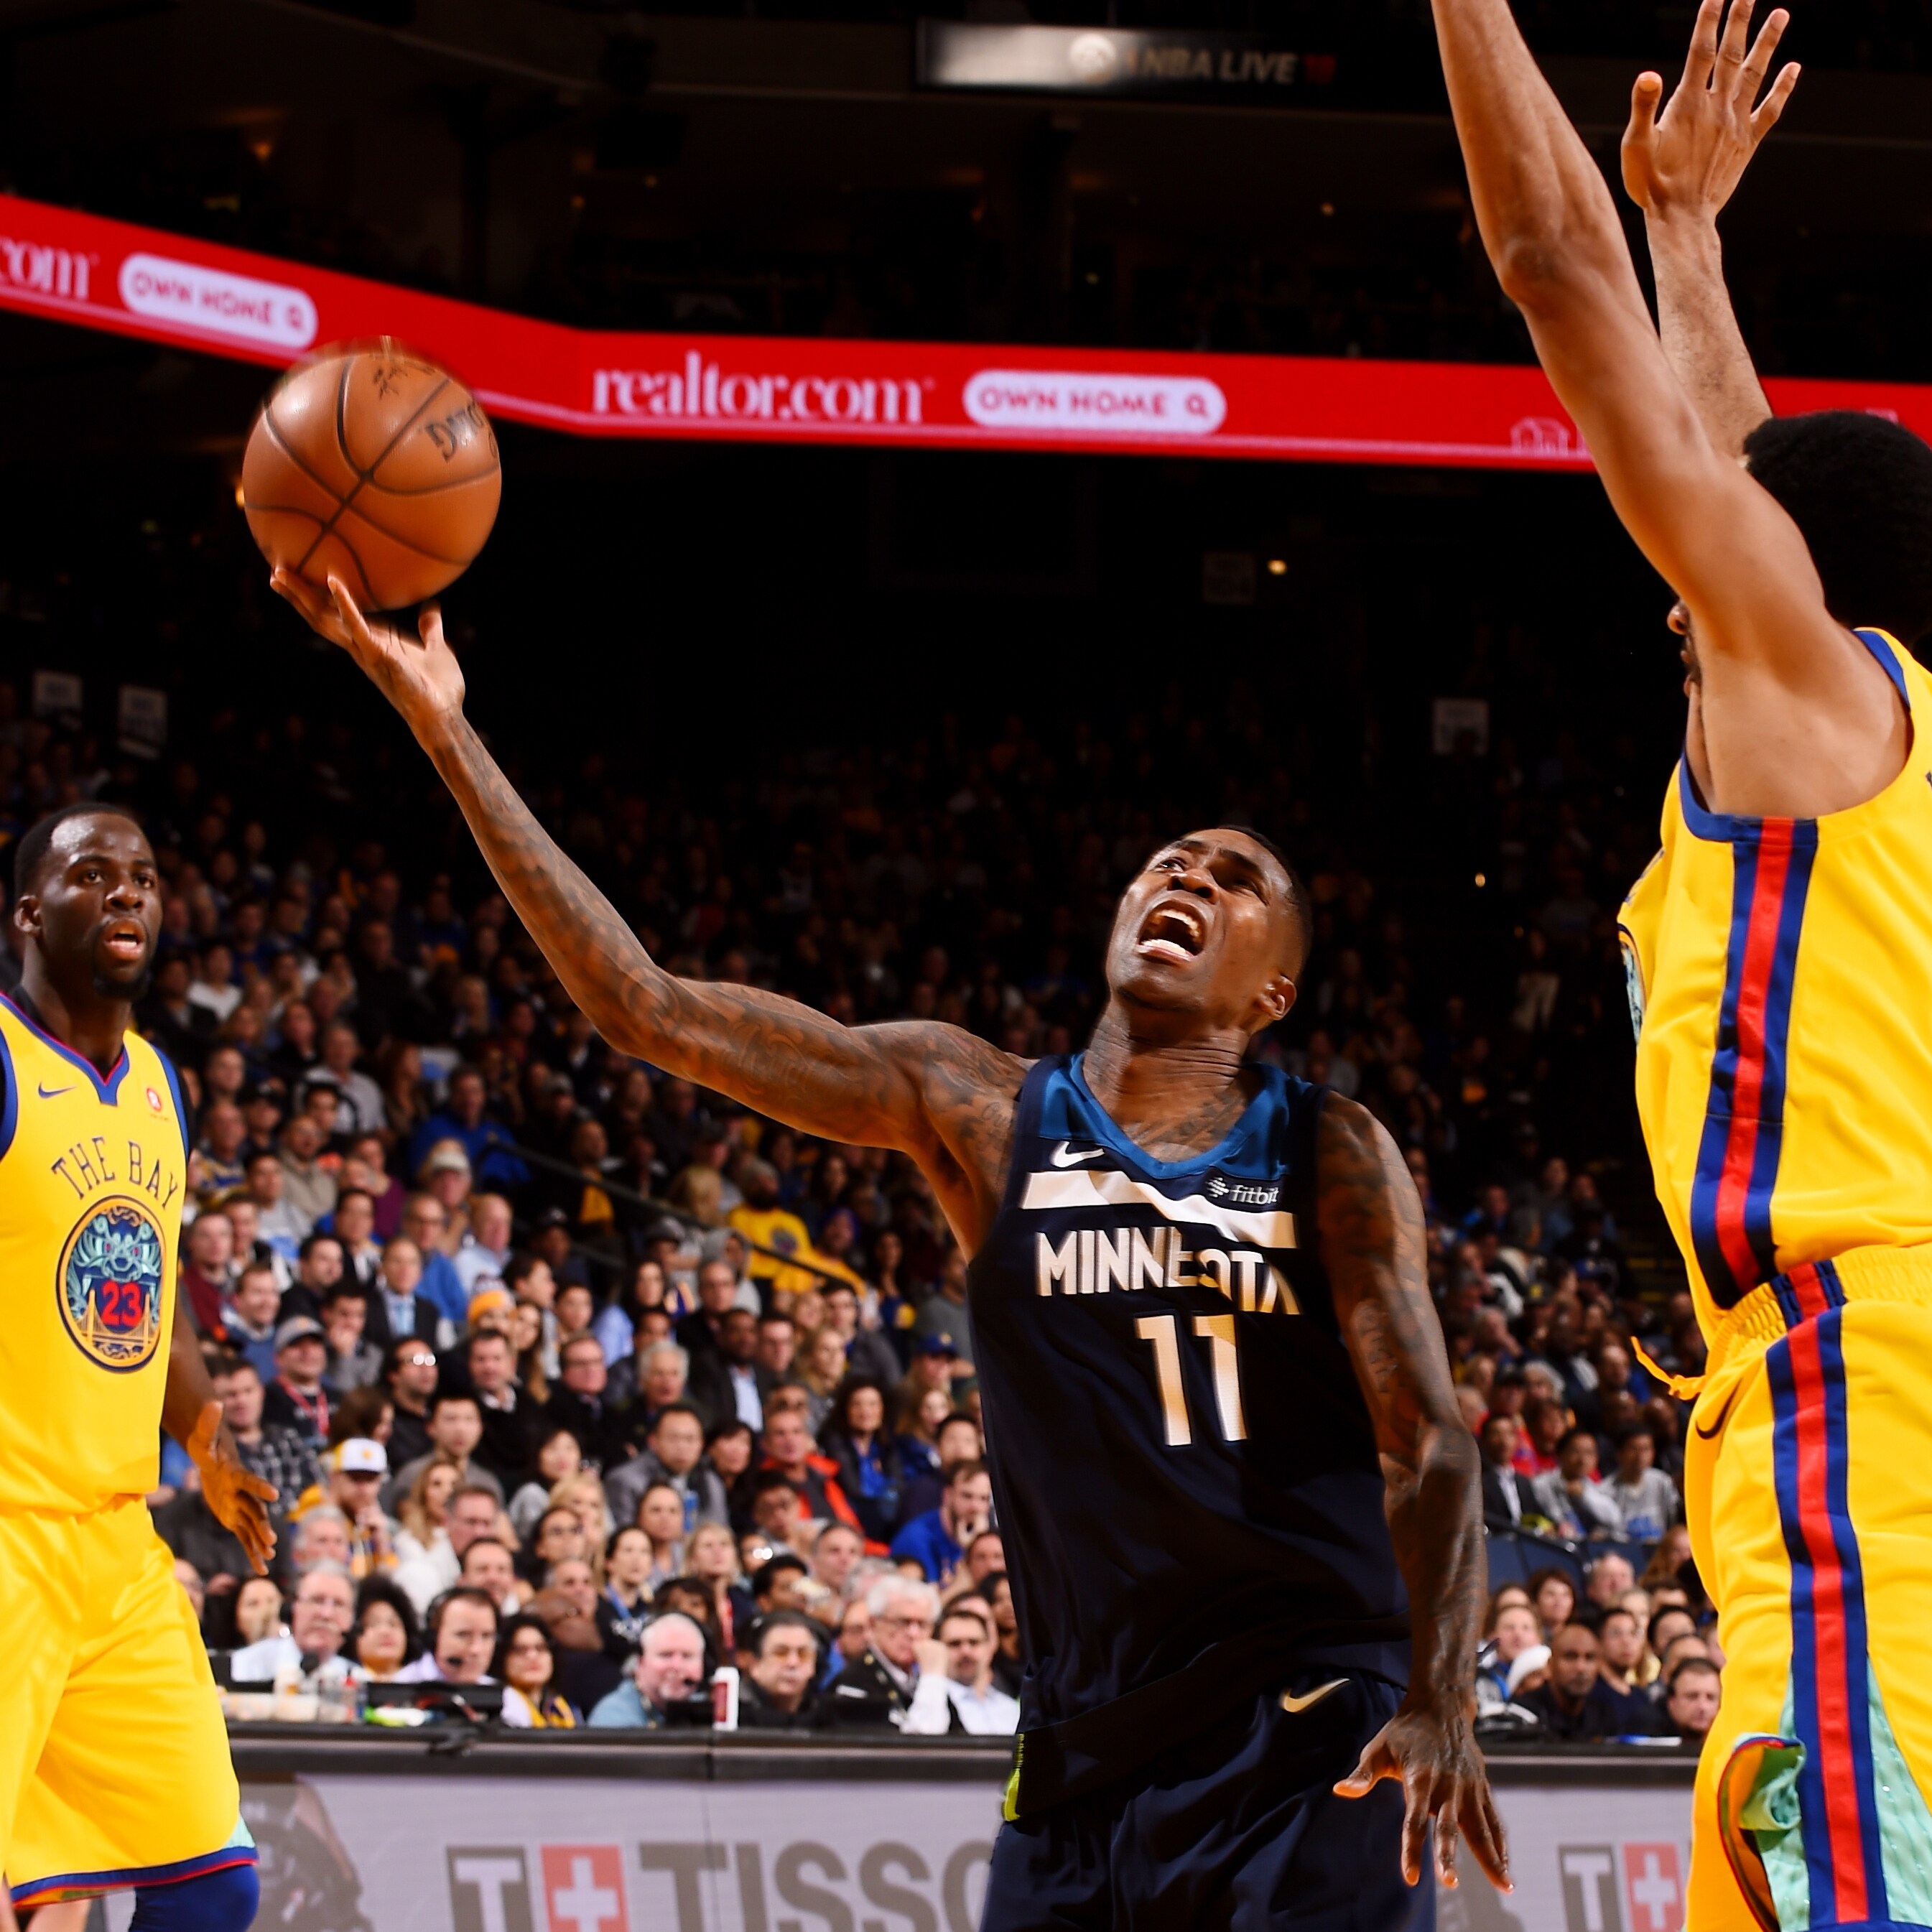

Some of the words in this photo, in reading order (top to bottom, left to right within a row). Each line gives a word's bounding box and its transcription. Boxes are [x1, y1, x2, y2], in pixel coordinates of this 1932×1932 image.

[1143, 48, 1213, 79] NBA
[1222, 51, 1299, 83] LIVE
[132, 270, 192, 303] OWN
[200, 289, 271, 325] HOME
[593, 349, 923, 424] realtor.com
[979, 386, 1057, 411] OWN
[1069, 391, 1166, 417] HOME
[51, 1136, 115, 1199] THE
[128, 1141, 178, 1210] BAY
[101, 1281, 142, 1327] 23
[1133, 1314, 1248, 1446] 11
